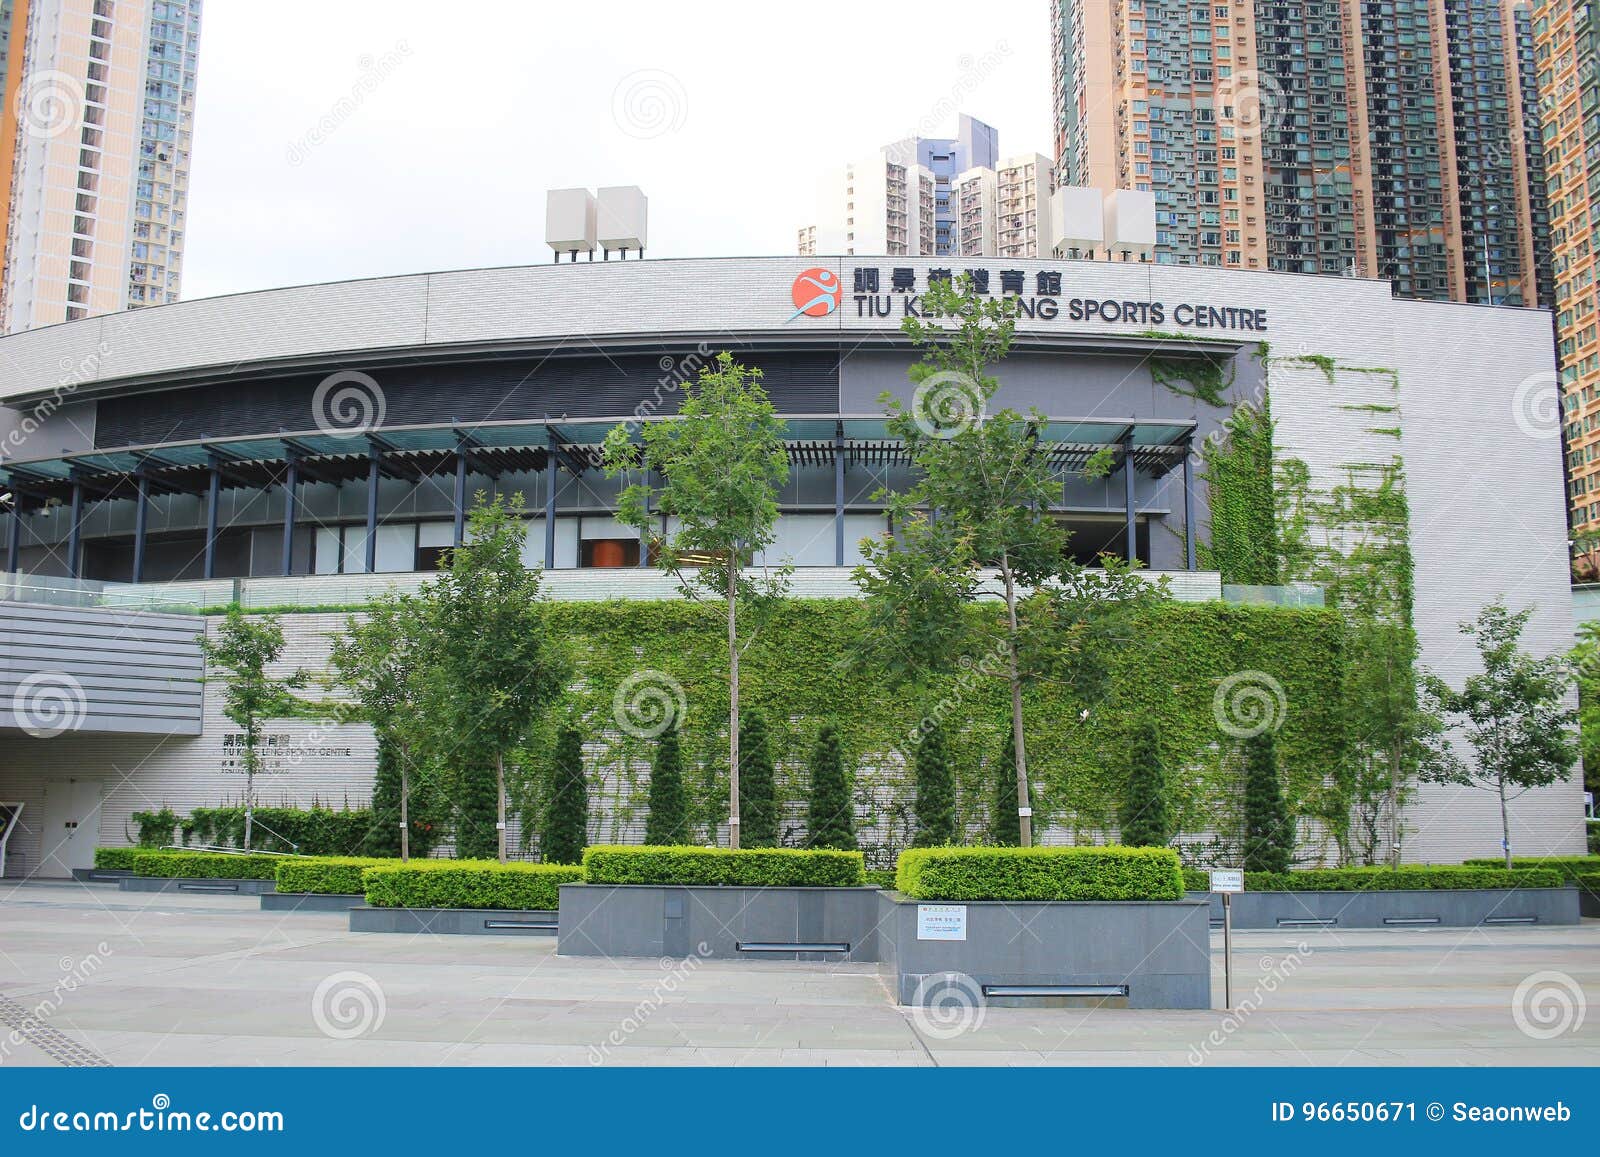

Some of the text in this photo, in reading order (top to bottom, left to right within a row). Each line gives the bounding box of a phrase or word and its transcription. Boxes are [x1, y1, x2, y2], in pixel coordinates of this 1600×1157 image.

[854, 295, 891, 317] TIU
[1069, 298, 1165, 324] SPORTS
[1173, 303, 1268, 331] CENTRE
